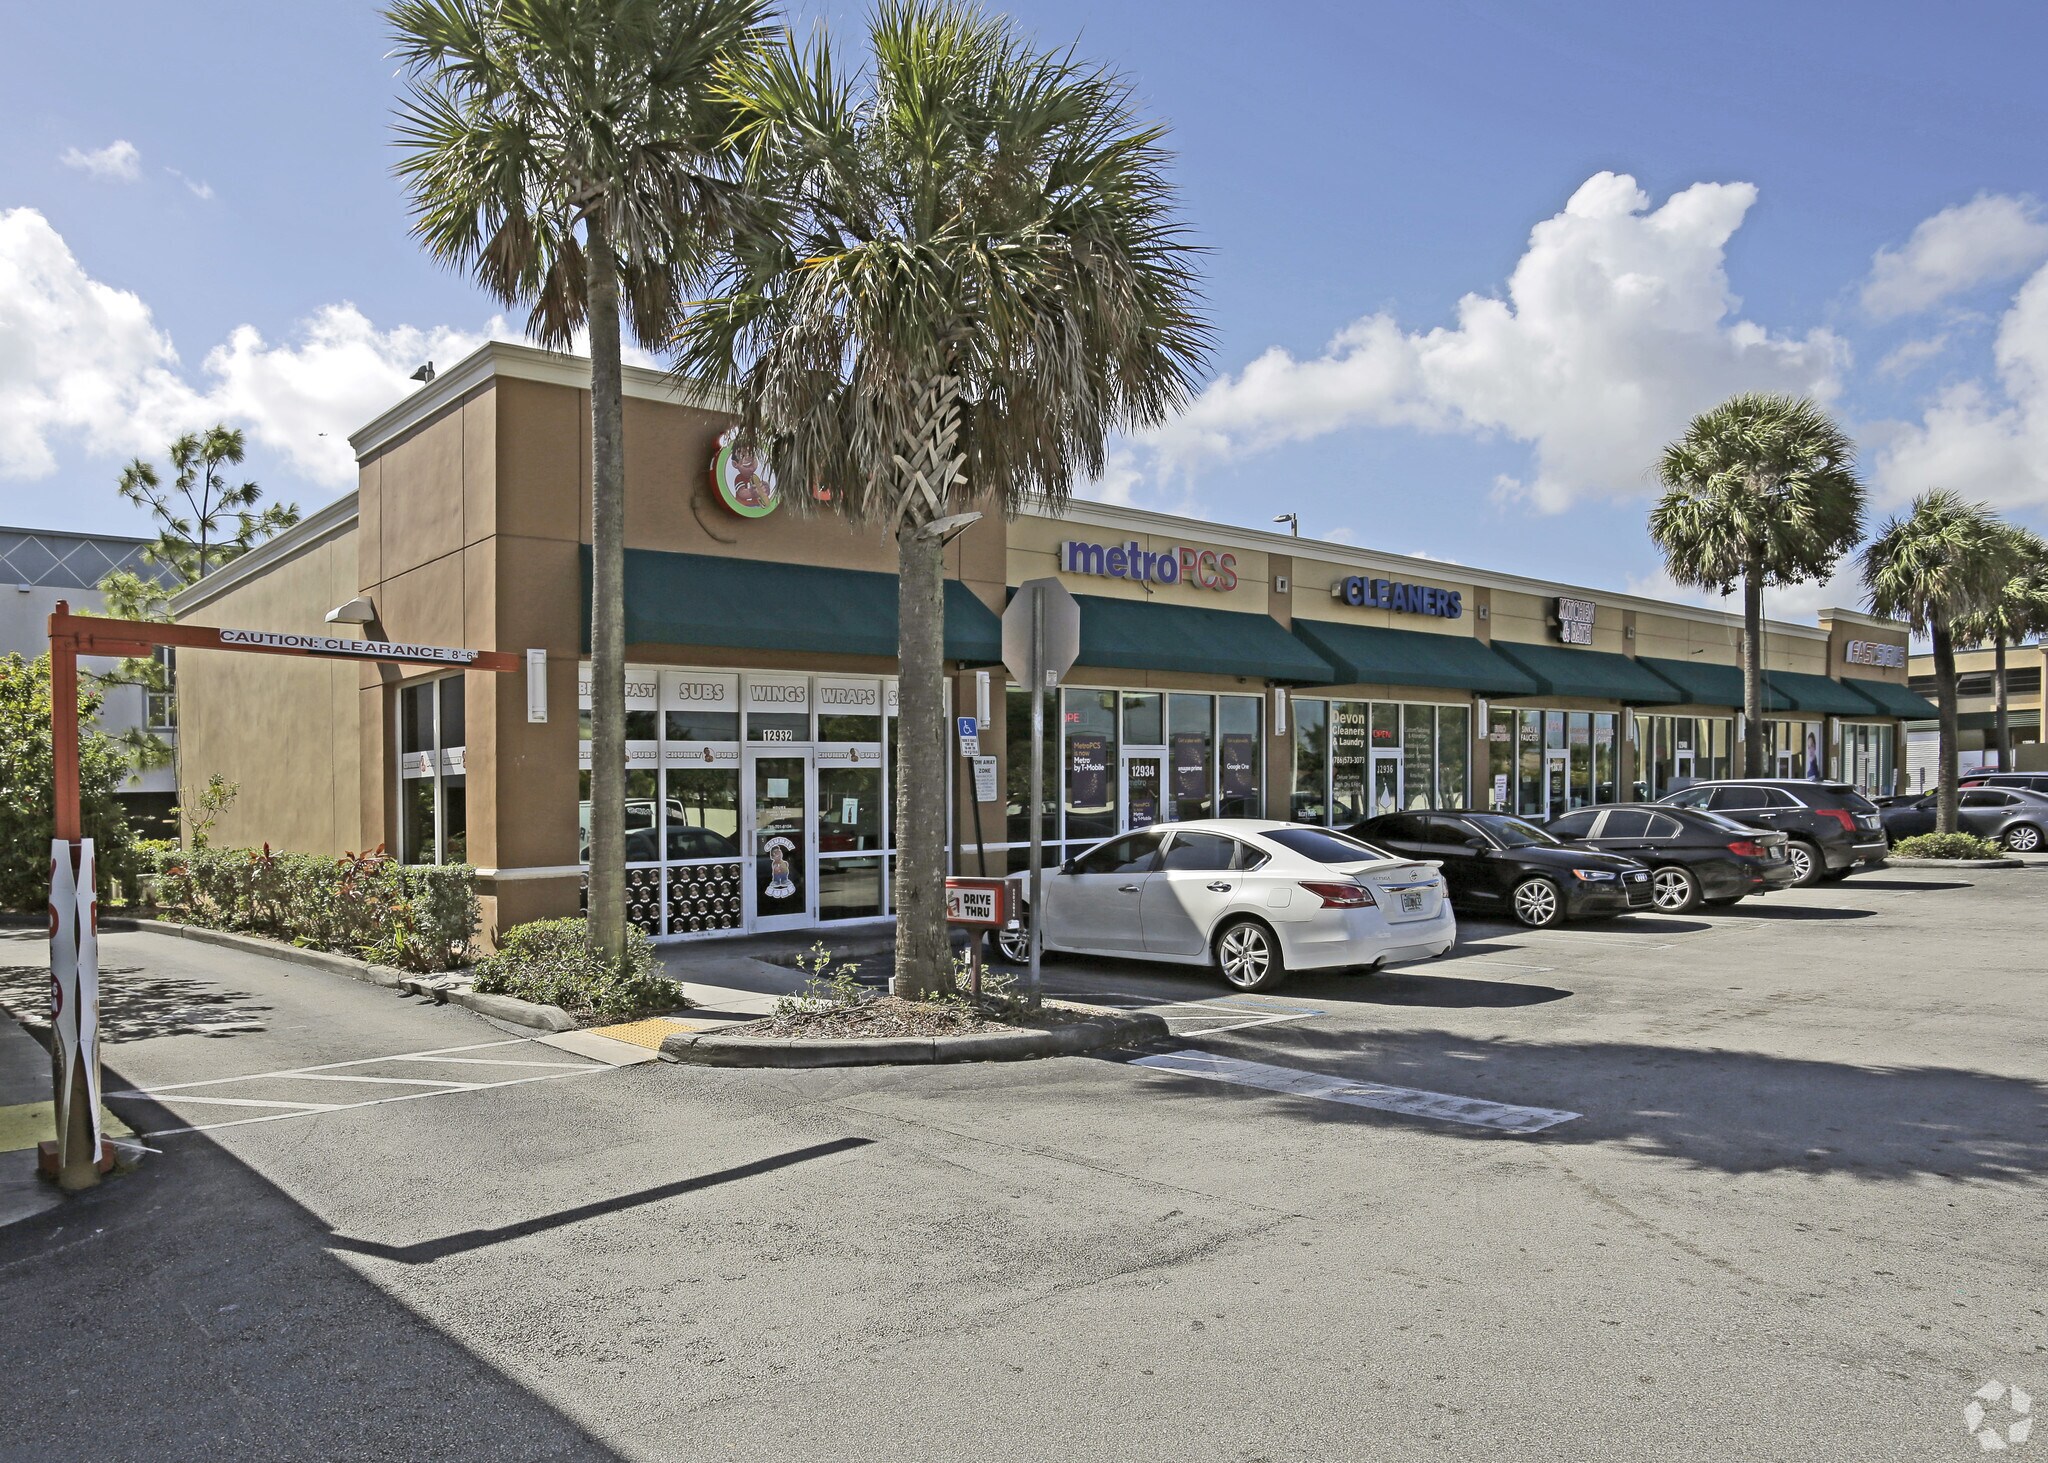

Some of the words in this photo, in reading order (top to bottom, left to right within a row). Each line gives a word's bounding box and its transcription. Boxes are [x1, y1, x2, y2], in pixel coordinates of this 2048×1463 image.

[1062, 539, 1238, 592] metroPCS
[1343, 576, 1462, 619] CLEANERS
[220, 630, 319, 649] CAUTION:
[324, 639, 444, 659] CLEARANCE
[679, 682, 724, 701] SUBS
[750, 685, 805, 703] WINGS
[821, 688, 875, 705] WRAPS
[1332, 710, 1365, 724] Devon
[764, 730, 792, 742] 12932
[1332, 725, 1365, 736] Cleaners
[1372, 729, 1391, 738] OPEN
[1332, 738, 1338, 746] &
[1339, 738, 1364, 748] Laundry
[666, 751, 702, 759] CHUNKY
[1073, 764, 1081, 772] by
[1081, 763, 1105, 771] T-Mobile
[1131, 765, 1155, 777] 12934
[1226, 763, 1241, 771] Google
[963, 893, 991, 905] DRIVE
[965, 905, 990, 918] THRU
